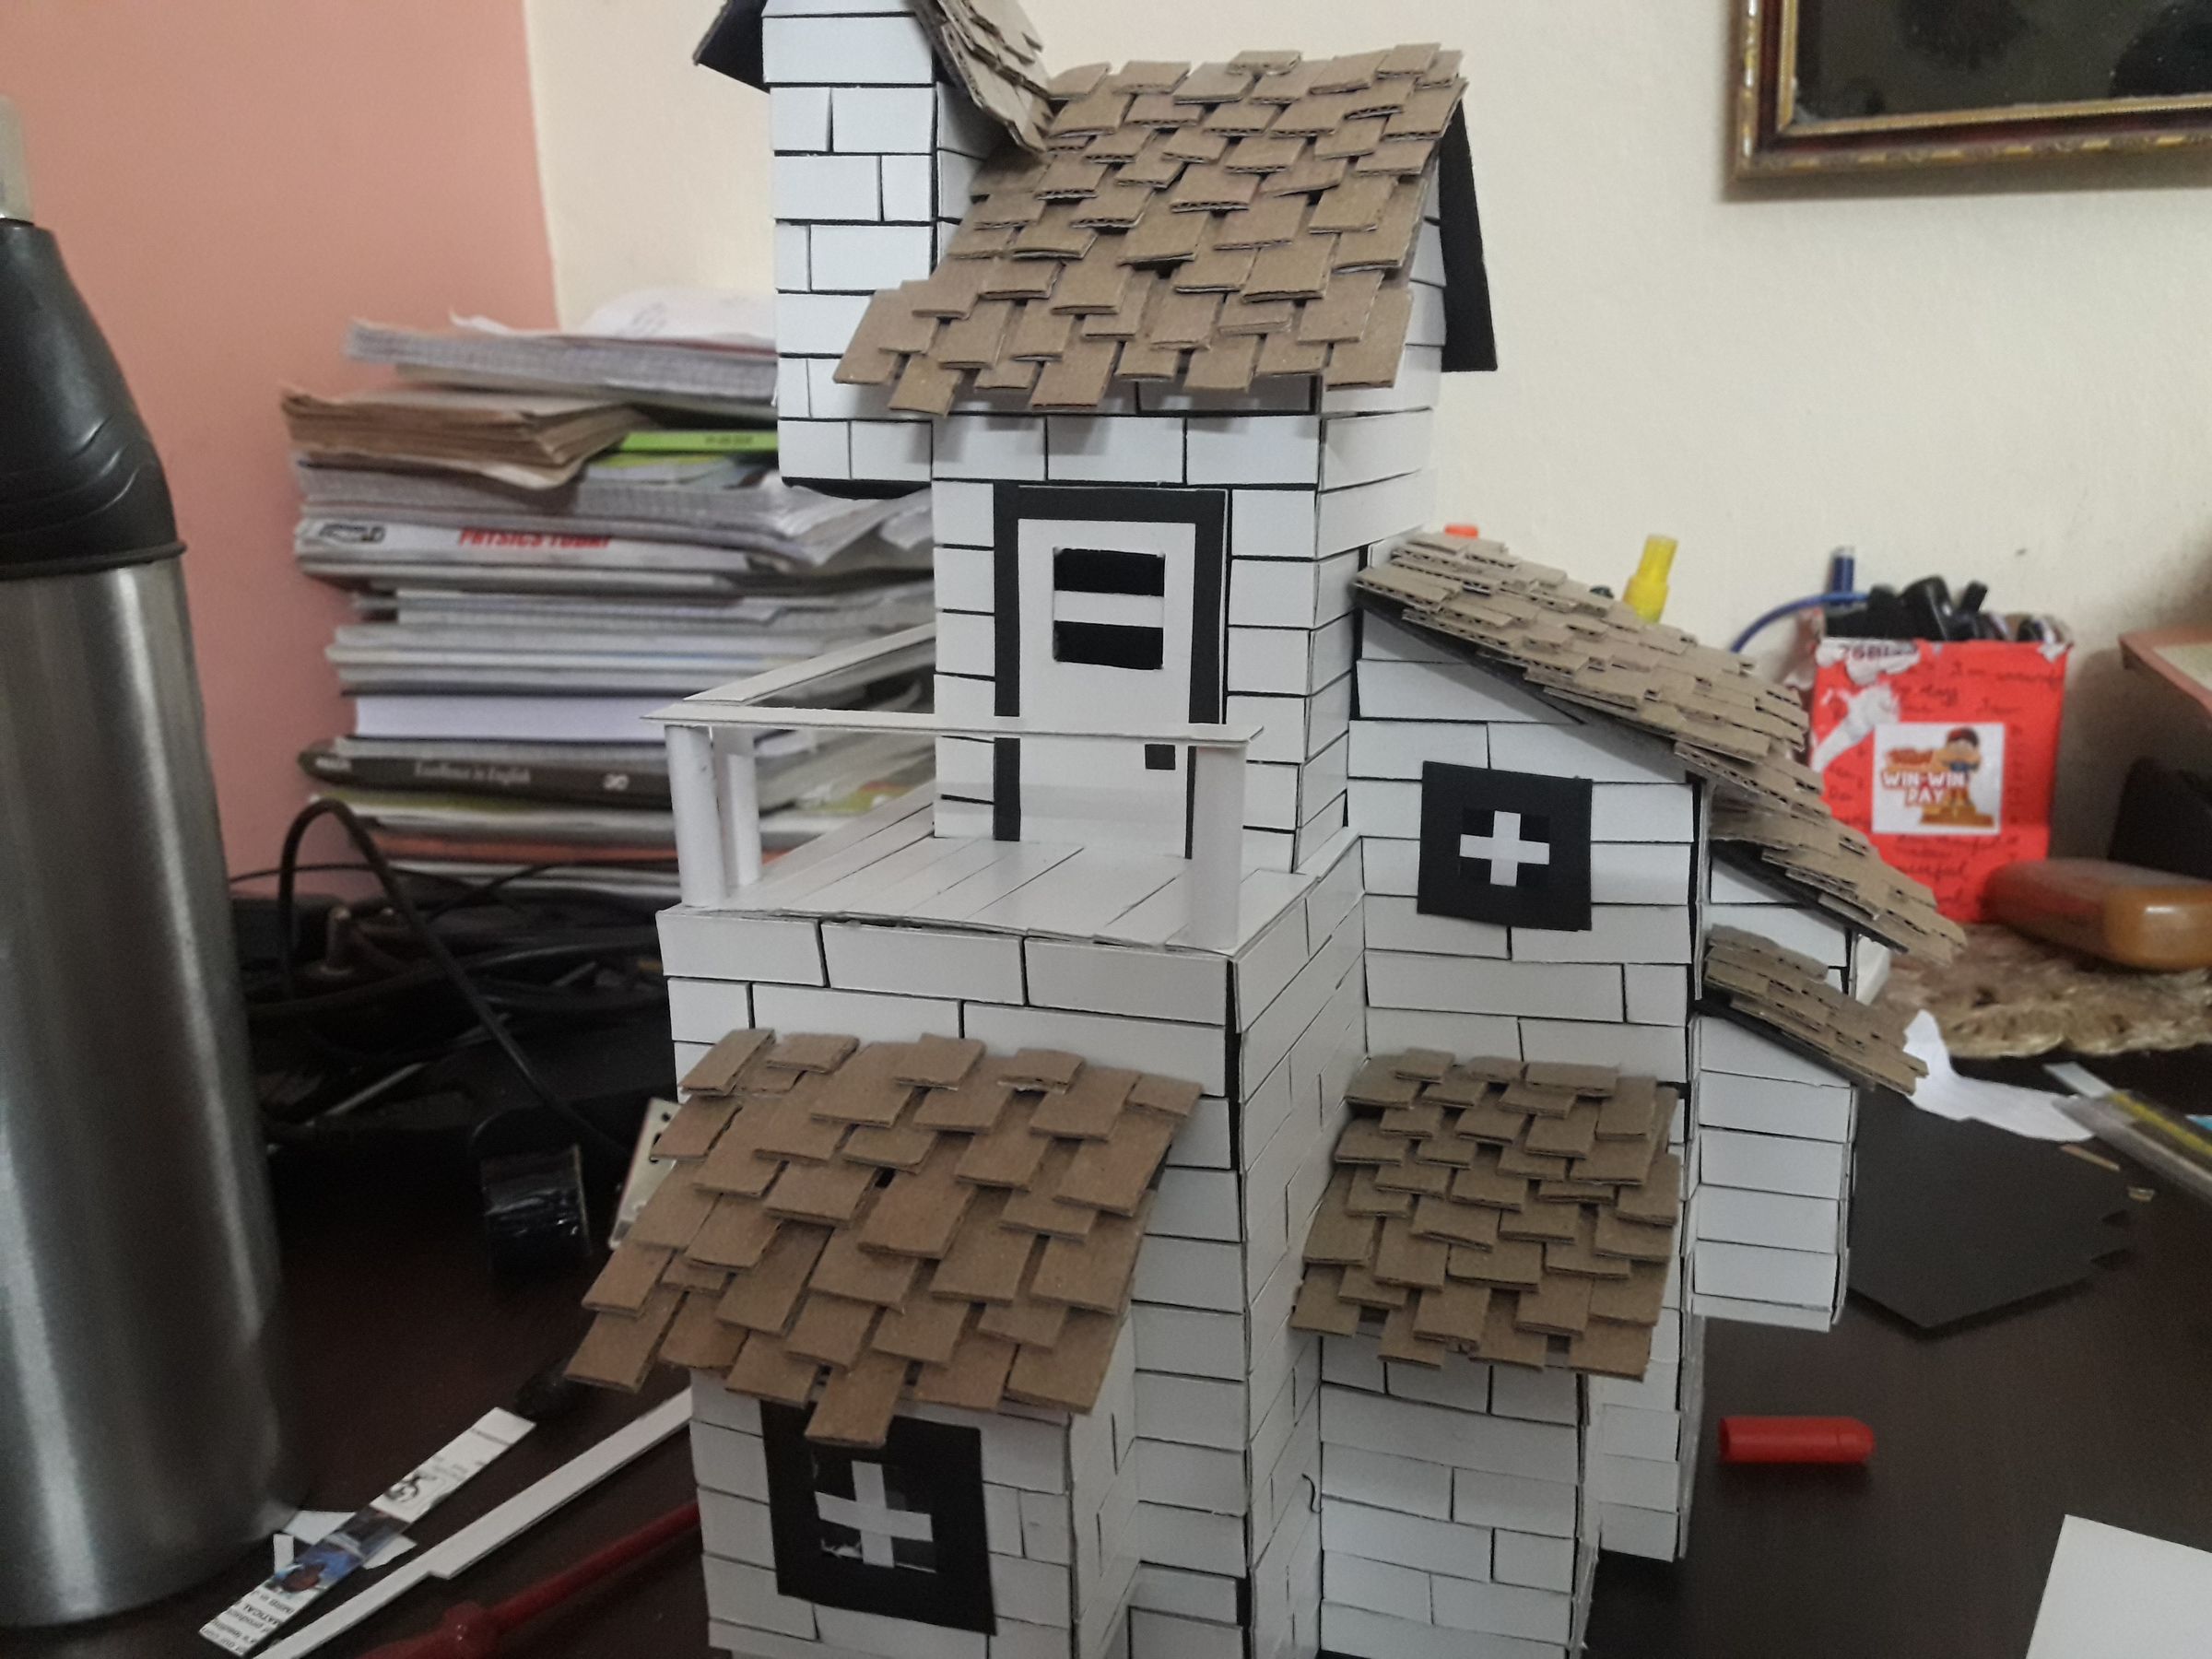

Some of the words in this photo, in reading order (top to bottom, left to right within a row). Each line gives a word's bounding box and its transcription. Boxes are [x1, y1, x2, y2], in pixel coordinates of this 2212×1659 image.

[458, 526, 542, 548] PHYSICS
[548, 532, 614, 548] TODAY
[488, 768, 531, 786] English
[1881, 771, 1967, 790] WIN-WIN
[1905, 787, 1947, 807] DAY
